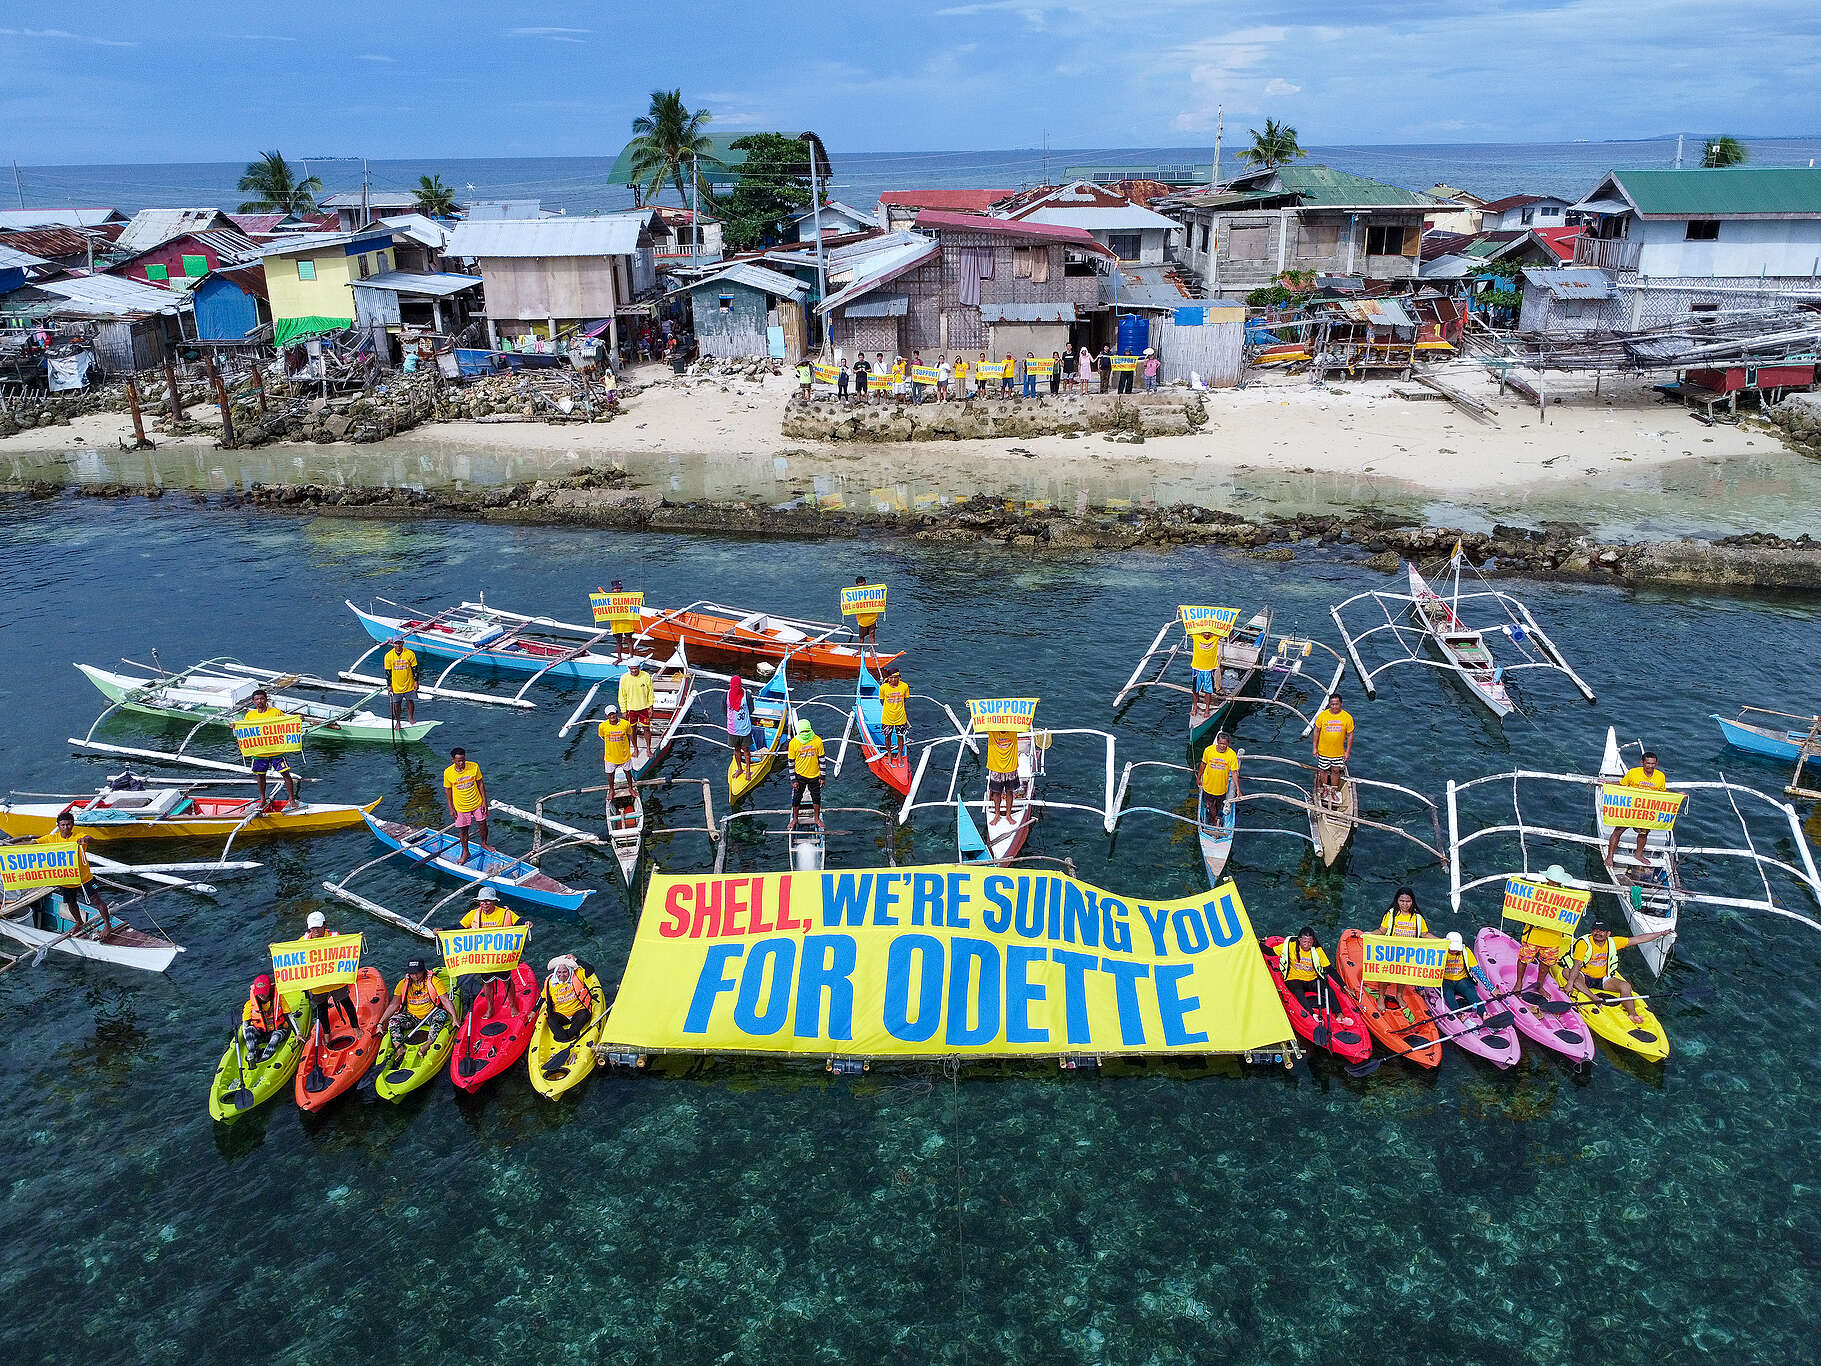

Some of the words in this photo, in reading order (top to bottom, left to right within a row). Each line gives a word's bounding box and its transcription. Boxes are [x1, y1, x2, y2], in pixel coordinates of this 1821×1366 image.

[592, 598, 611, 607] MAKE
[612, 597, 641, 606] CLIMATE
[846, 589, 886, 601] SUPPORT
[593, 605, 629, 616] POLLUTERS
[630, 606, 641, 614] PAY
[841, 602, 852, 611] THE
[1184, 609, 1189, 621] I
[1190, 608, 1236, 622] SUPPORT
[1184, 622, 1195, 630] THE
[972, 702, 977, 714] I
[979, 700, 1035, 714] SUPPORT
[973, 716, 985, 726] THE
[235, 726, 261, 739] MAKE
[262, 723, 301, 736] CLIMATE
[238, 734, 285, 750] POLLUTERS
[286, 733, 301, 744] PAY
[1603, 794, 1632, 807] MAKE
[1634, 797, 1679, 814] CLIMATE
[1602, 806, 1656, 821] POLLUTERS
[1657, 812, 1675, 823] PAY
[0, 856, 6, 872] I
[8, 851, 76, 871] SUPPORT
[2, 873, 17, 884] THE
[18, 868, 80, 881] #ODETTECASE
[1535, 889, 1585, 913] CLIMATE
[659, 875, 813, 938] SHELL,
[821, 872, 970, 928] WE'RE
[982, 875, 1132, 953] SUING
[1137, 894, 1243, 956] YOU
[1505, 895, 1557, 919] OLLUTERS
[1558, 909, 1580, 926] PAY
[445, 938, 450, 956] I
[453, 932, 524, 952] SUPPORT
[273, 951, 307, 969] MAKE
[310, 945, 359, 962] CLIMATE
[446, 958, 460, 970] THE
[461, 951, 521, 965] #ODETTECASE
[1366, 944, 1372, 961] I
[1375, 945, 1446, 967] SUPPORT
[274, 961, 335, 984] POLLUTERS
[336, 960, 358, 974] PAY
[1364, 962, 1380, 974] THE
[1382, 964, 1444, 980] #ODETTECASE
[683, 934, 857, 1041] FOR
[883, 933, 1209, 1047] ODETTE
